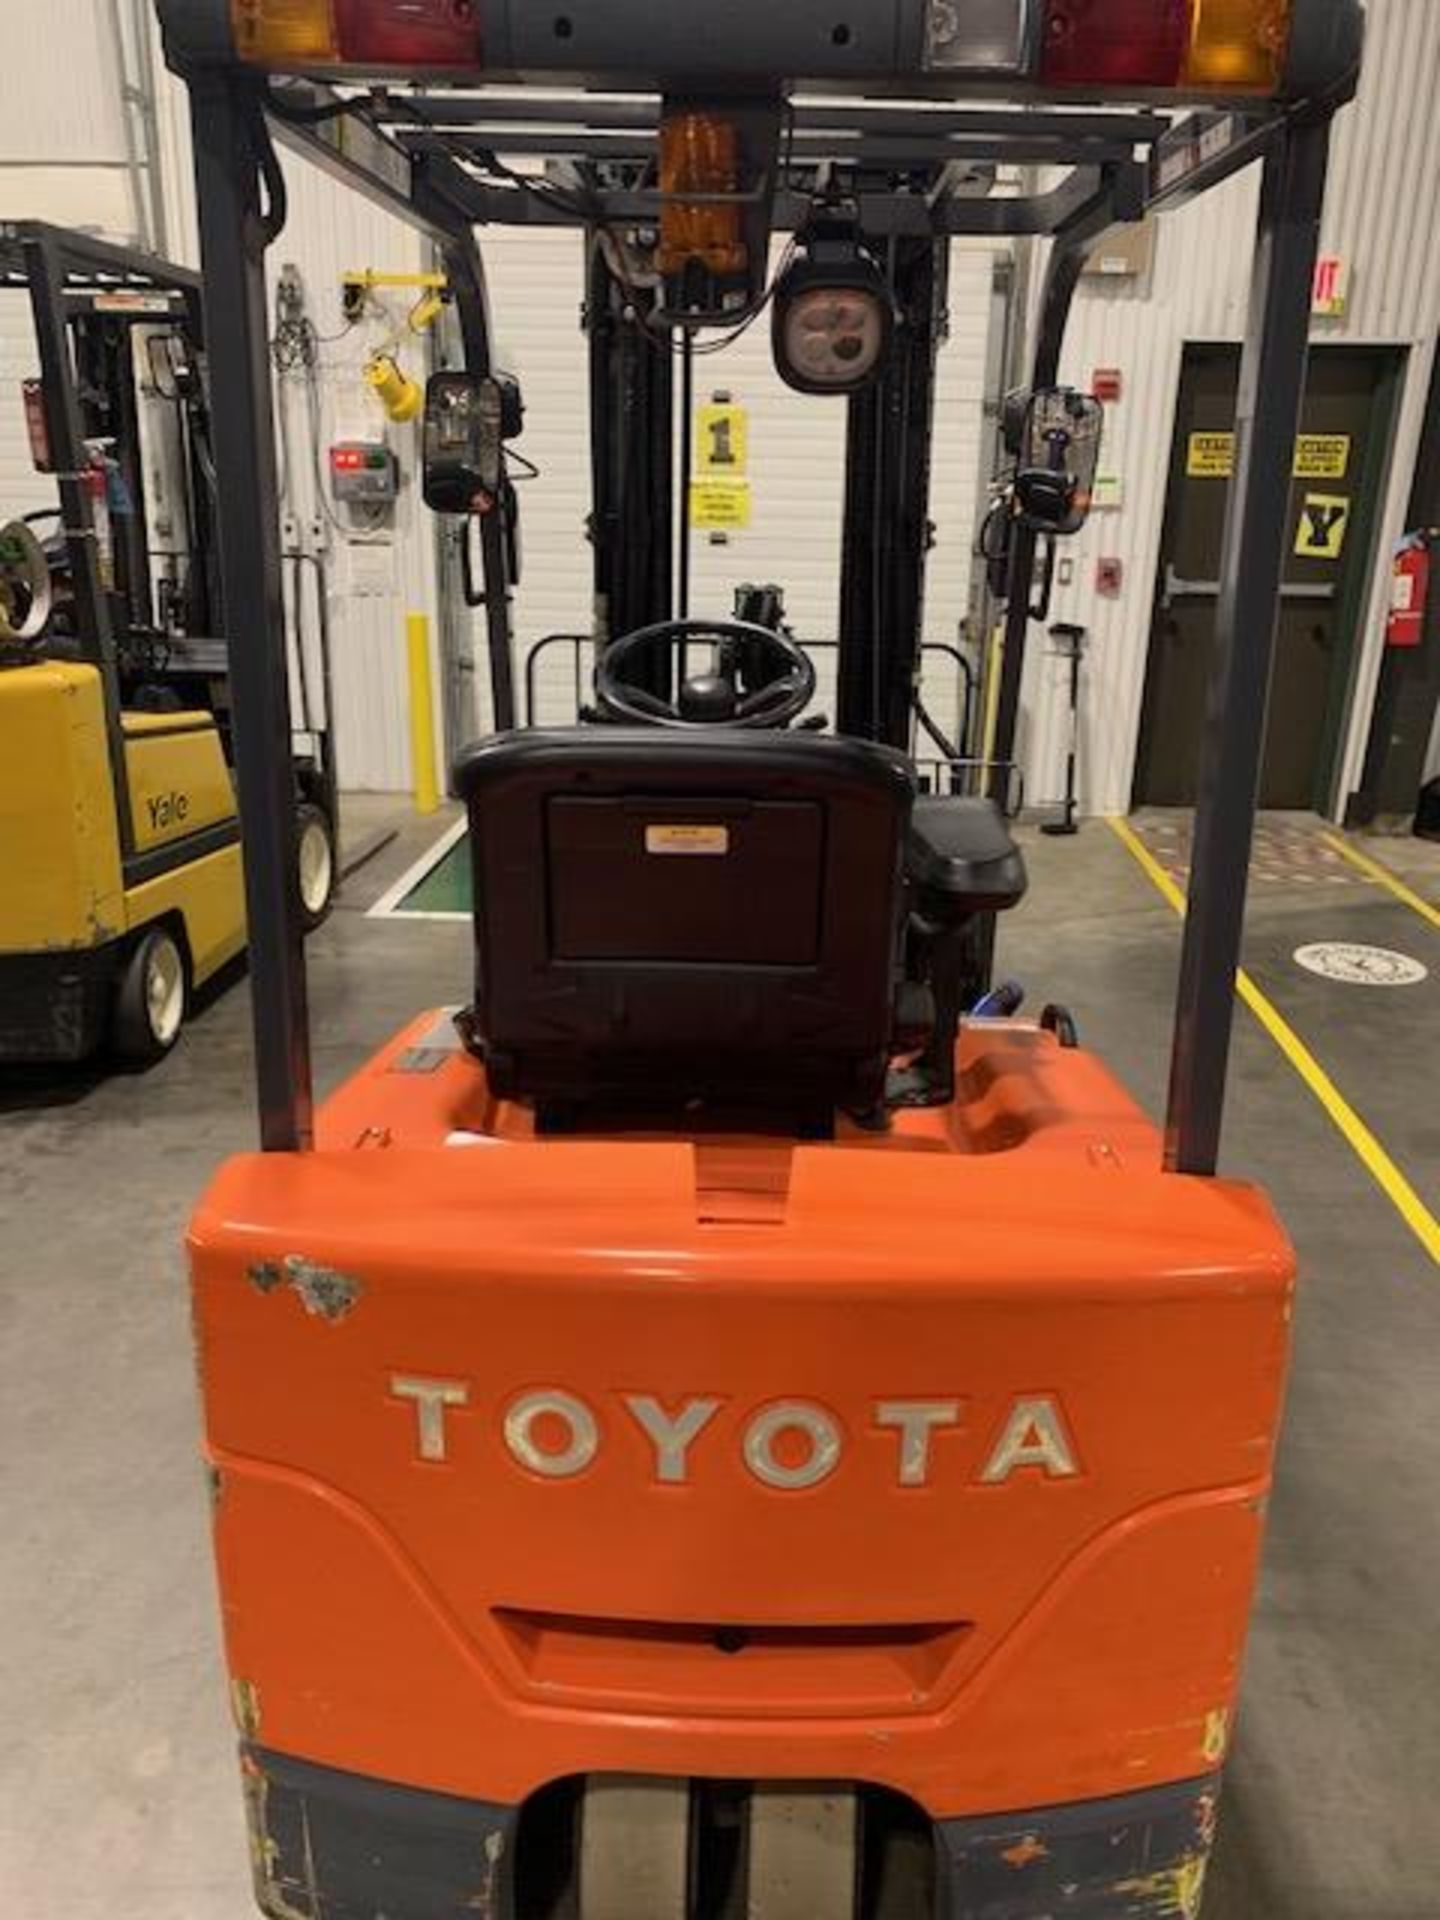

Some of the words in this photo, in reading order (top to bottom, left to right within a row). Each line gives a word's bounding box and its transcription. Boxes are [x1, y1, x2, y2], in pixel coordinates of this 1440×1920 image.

[708, 417, 735, 463] 1
[1305, 504, 1345, 547] Y
[146, 791, 189, 830] Yale
[391, 1374, 1079, 1489] TOYOTA
